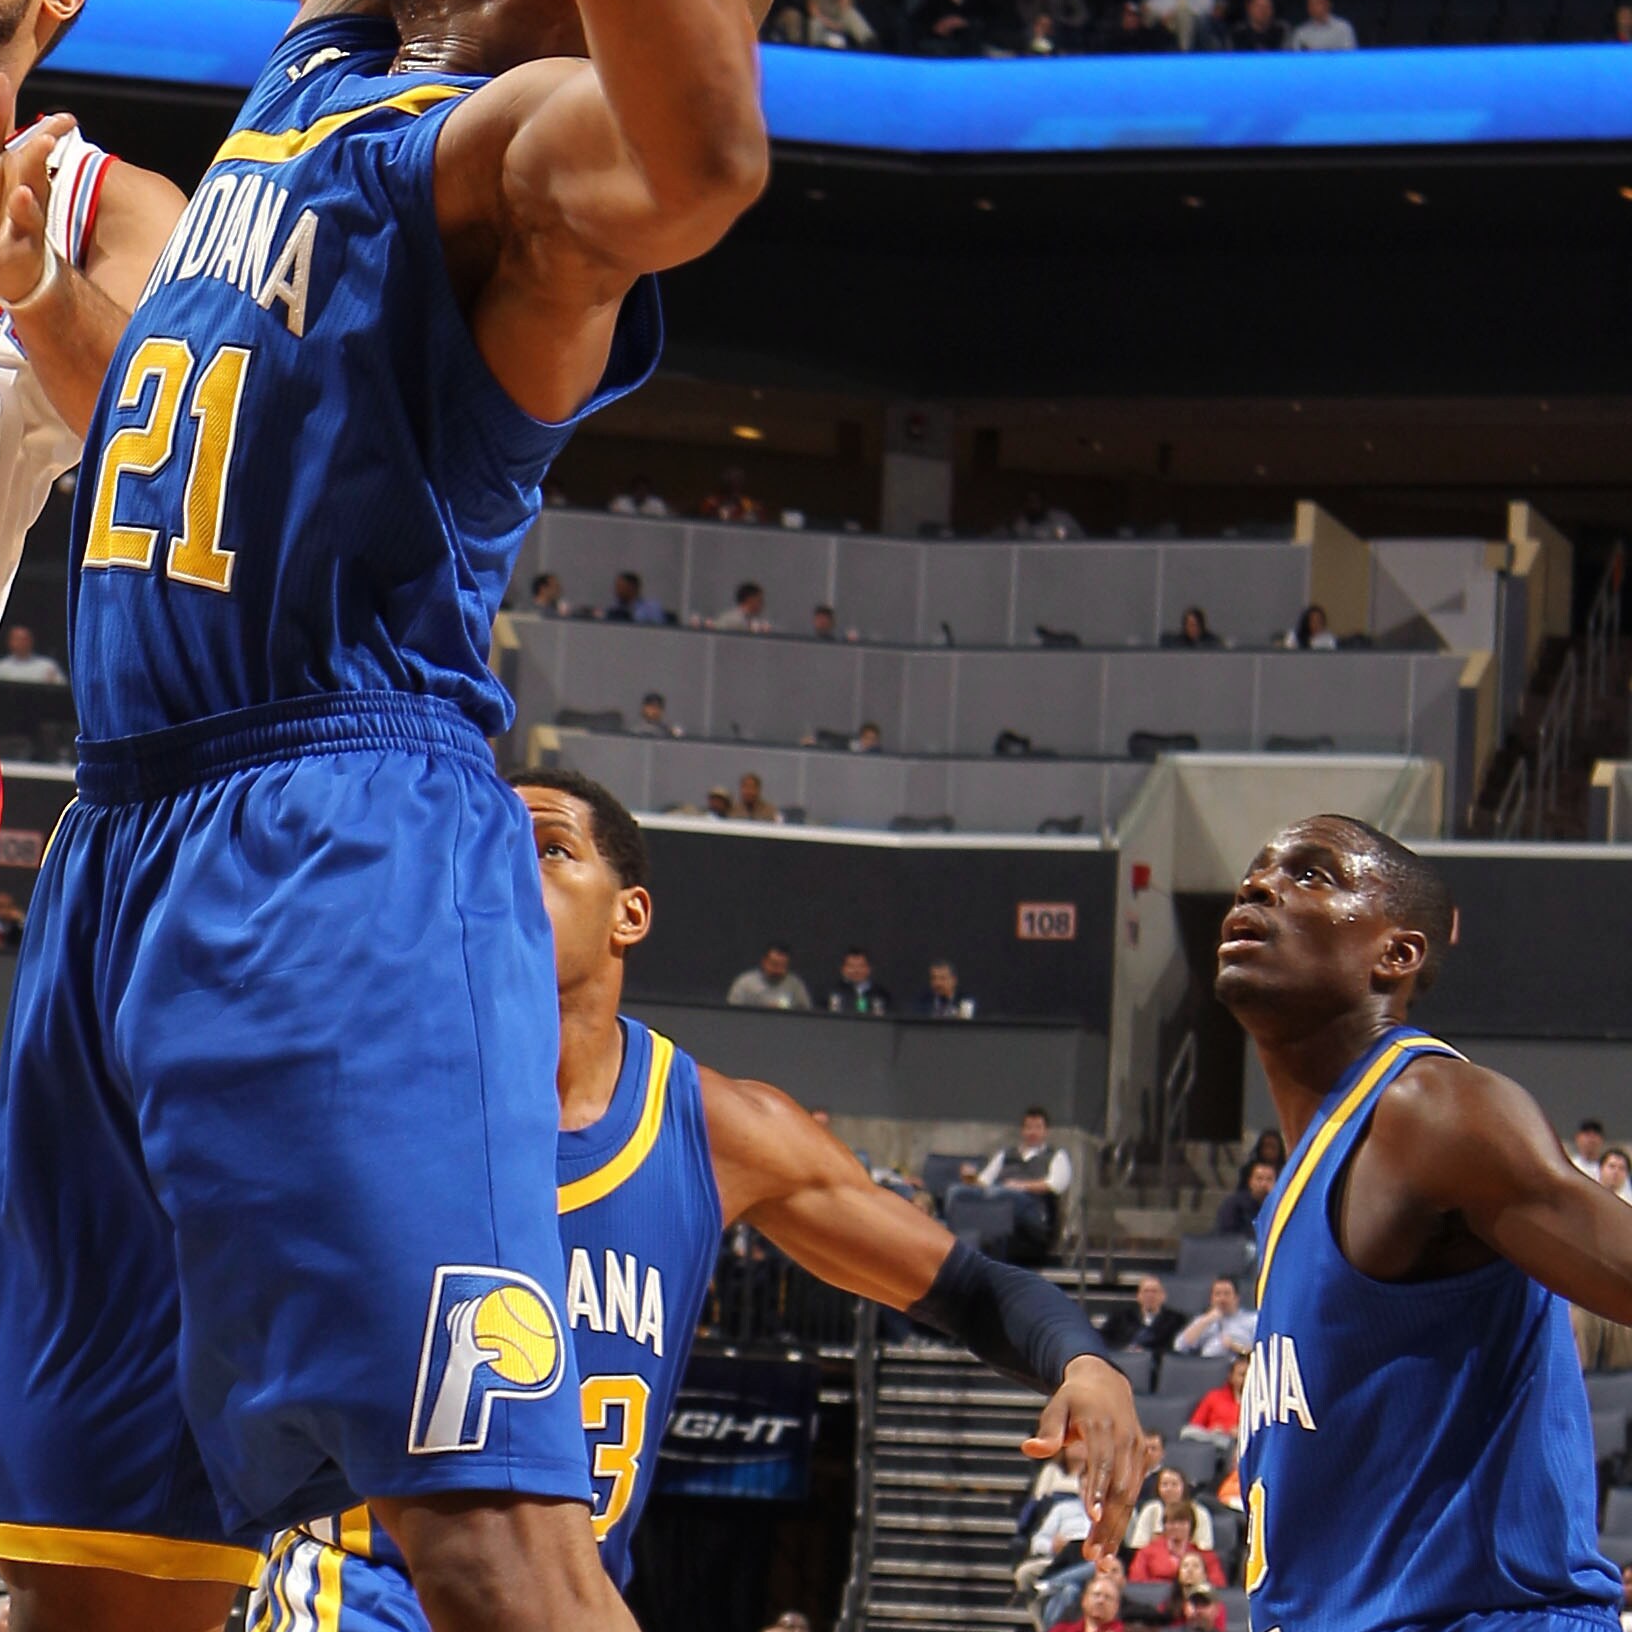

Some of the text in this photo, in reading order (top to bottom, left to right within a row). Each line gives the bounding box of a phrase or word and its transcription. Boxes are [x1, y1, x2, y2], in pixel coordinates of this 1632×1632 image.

[81, 337, 252, 593] 21
[1023, 911, 1070, 937] 108
[568, 1247, 664, 1358] ANA
[670, 1411, 800, 1444] GHT
